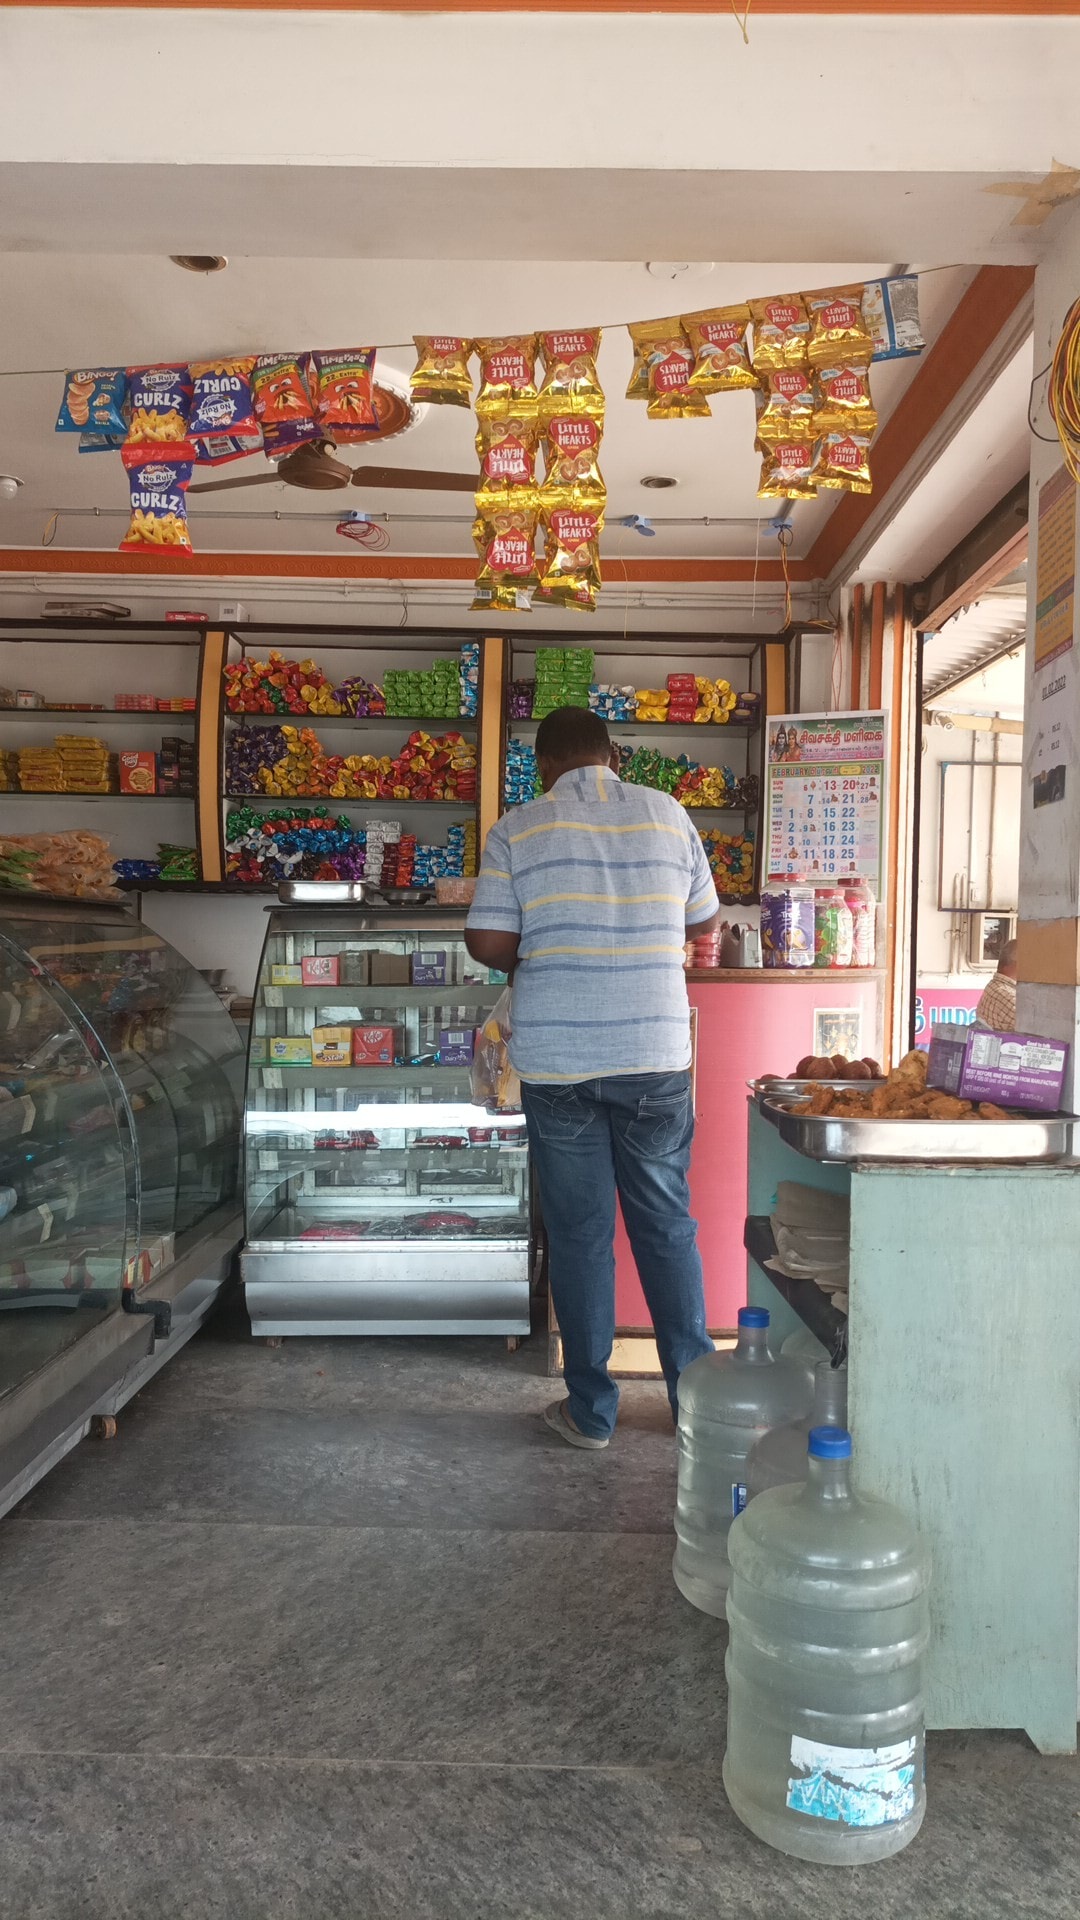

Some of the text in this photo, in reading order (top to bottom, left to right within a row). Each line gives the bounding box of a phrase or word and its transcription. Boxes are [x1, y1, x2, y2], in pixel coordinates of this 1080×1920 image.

[772, 315, 794, 323] HEARTS
[707, 323, 736, 334] LITTLE
[552, 335, 586, 346] LITTLE
[708, 330, 738, 341] HEARTS
[433, 343, 457, 351] HEARTS
[553, 343, 587, 354] HEARTS
[490, 355, 524, 367] HEARTS
[491, 366, 524, 379] LITTLE
[659, 361, 689, 374] HEARTS
[76, 371, 118, 382] BINGO!
[662, 373, 689, 385] LITTLE
[779, 376, 801, 384] LITTLE
[194, 377, 240, 394] CURLZ
[780, 384, 802, 392] HEARTS
[133, 392, 183, 409] CURLZ
[201, 402, 231, 415] No Rulz
[557, 422, 590, 434] LITTLE
[558, 433, 592, 446] HEARTS
[489, 447, 524, 460] HEARTS
[780, 449, 802, 458] LITTLE
[491, 459, 526, 473] LITTLE
[781, 457, 804, 465] HEARTS
[155, 473, 173, 481] Rulz
[131, 492, 180, 511] CURLZ
[558, 516, 590, 527] LITTLE
[558, 527, 592, 538] HEARTS
[493, 540, 527, 552] HEARTS
[495, 551, 527, 565] LITTLE
[800, 727, 883, 745] சிவசக்தி மளிகை
[121, 753, 139, 761] Good
[772, 767, 808, 777] FEBRUARY
[862, 765, 879, 773] 2022
[824, 780, 837, 790] 13
[842, 779, 856, 790] 20
[807, 794, 814, 804] 7
[842, 793, 855, 804] 21
[789, 808, 794, 818] 1
[807, 808, 814, 818] 8
[823, 807, 836, 818] 15
[842, 807, 855, 817] 22
[788, 822, 795, 832] 2
[803, 824, 808, 832] 9
[822, 821, 836, 831] 16
[841, 821, 855, 831] 23
[788, 836, 794, 846] 3
[822, 835, 835, 845] 17
[841, 835, 855, 845] 24
[803, 849, 815, 859] 11
[822, 849, 835, 859] 18
[841, 849, 854, 859] 25
[787, 863, 793, 873] 5
[822, 862, 835, 872] 19
[307, 960, 332, 974] KitKat
[363, 1030, 384, 1044] KitKat
